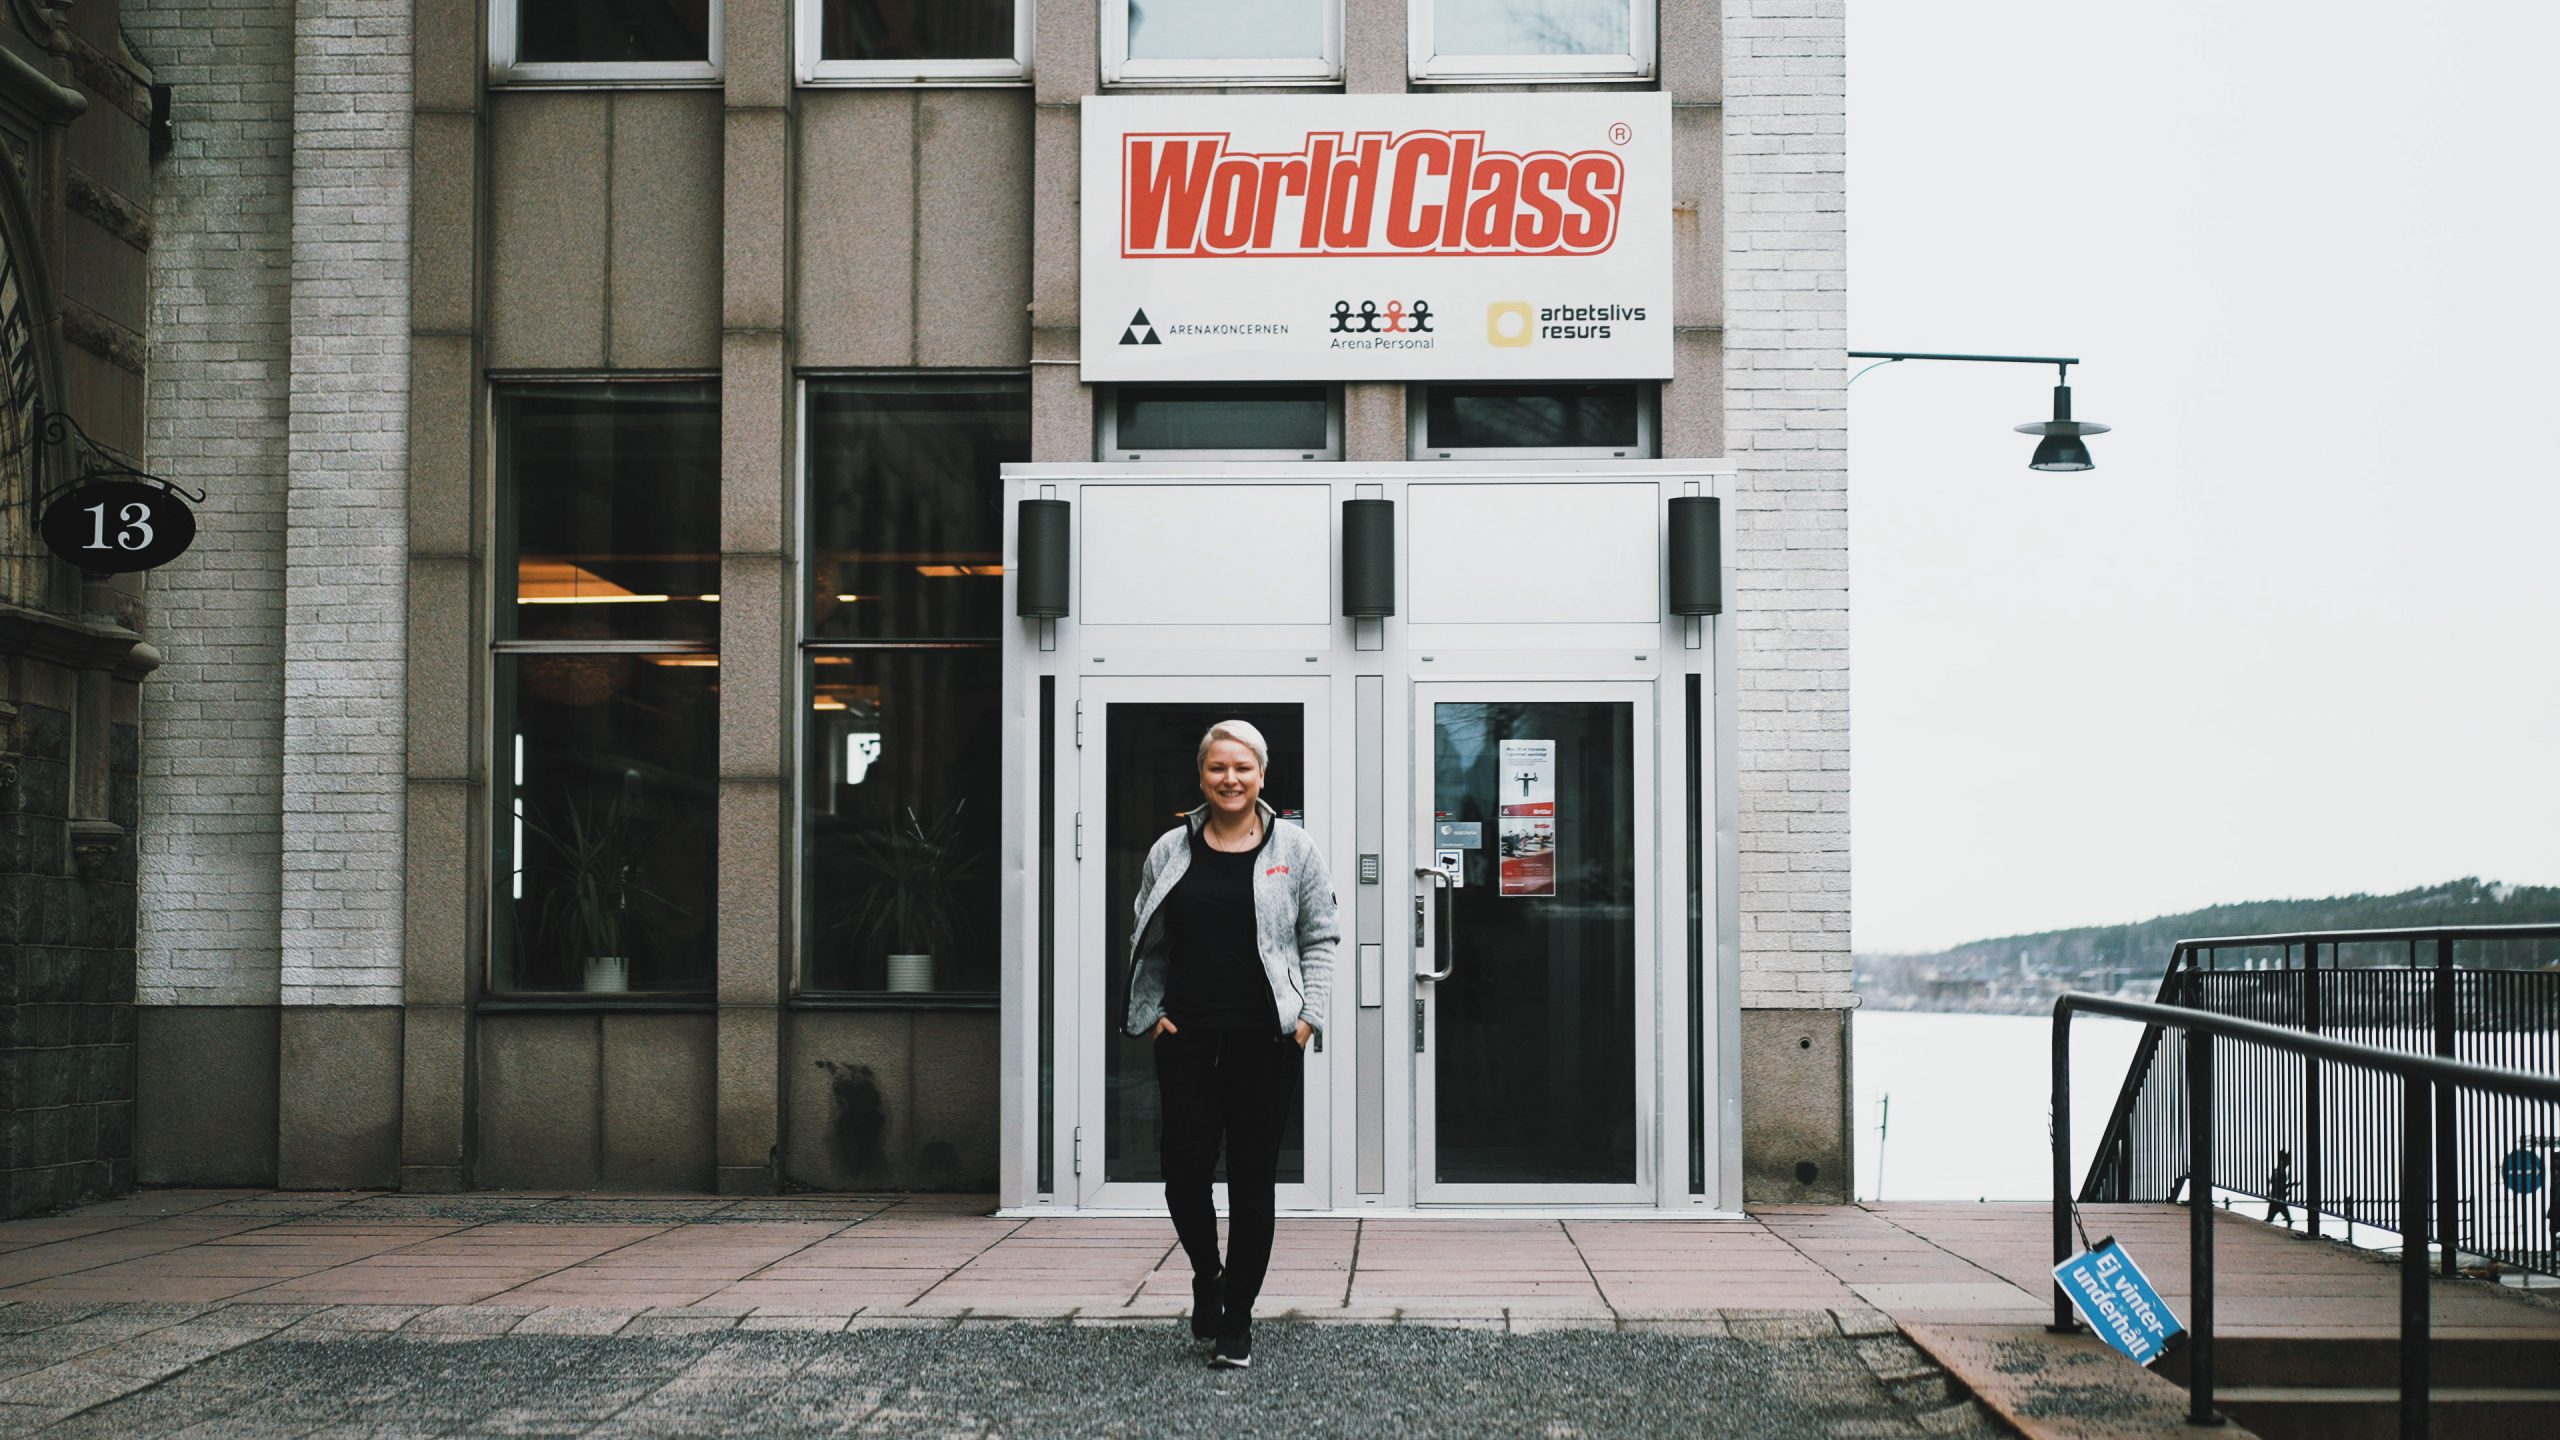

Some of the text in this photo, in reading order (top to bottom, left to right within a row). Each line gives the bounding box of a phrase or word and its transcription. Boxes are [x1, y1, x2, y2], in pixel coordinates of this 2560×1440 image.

[1129, 136, 1617, 251] World Class
[1541, 304, 1646, 321] arbetslivs
[1169, 324, 1289, 335] ARENAKONCERNEN
[1330, 337, 1434, 350] Arena Personal
[1541, 324, 1611, 339] resurs
[82, 502, 154, 550] 13
[2095, 1252, 2165, 1338] Ej vinter-
[2072, 1266, 2150, 1358] underhåll
